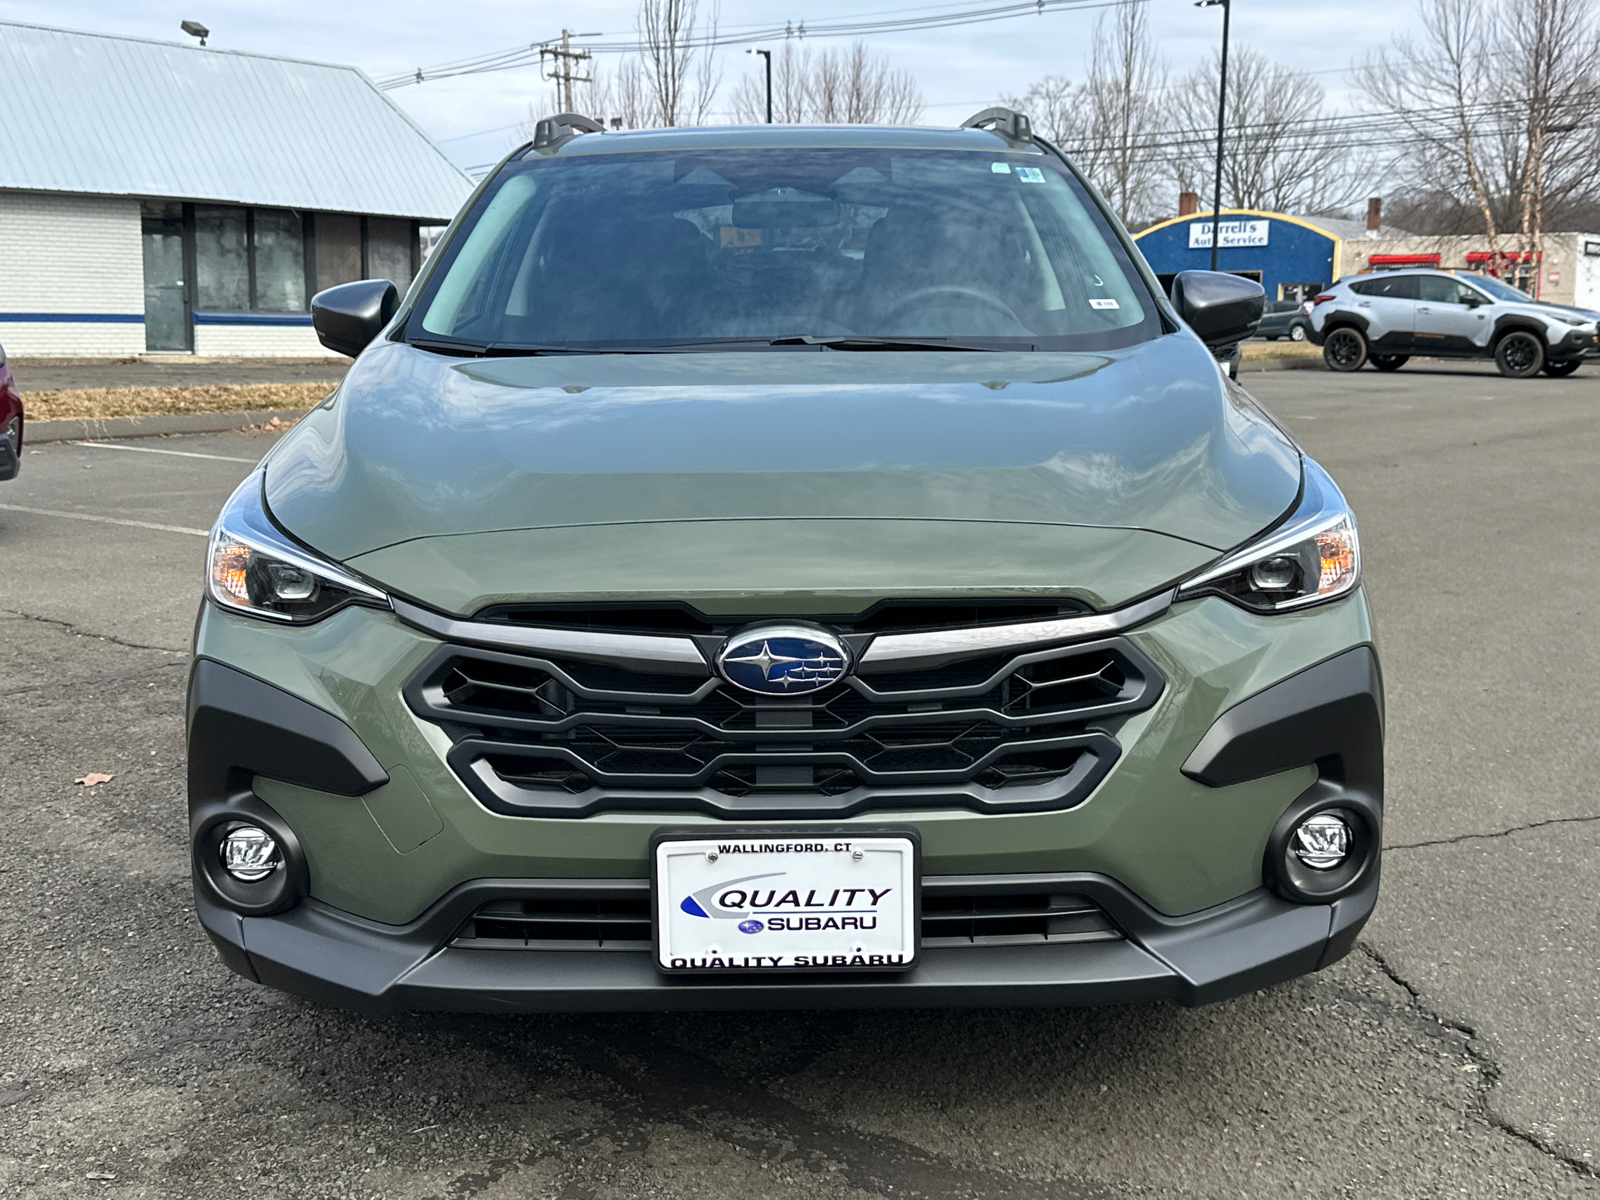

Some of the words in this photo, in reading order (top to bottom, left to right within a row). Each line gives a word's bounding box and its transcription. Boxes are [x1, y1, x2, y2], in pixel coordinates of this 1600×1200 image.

[1201, 221, 1257, 235] Drrell's
[1193, 237, 1219, 246] Aut
[1223, 235, 1264, 245] Service
[717, 843, 828, 854] WALLINGFORD,
[834, 842, 852, 852] CT
[718, 888, 893, 909] QUALITY
[767, 916, 877, 931] SUBARU
[670, 956, 783, 968] QUALITY
[793, 954, 903, 967] SUBARU
